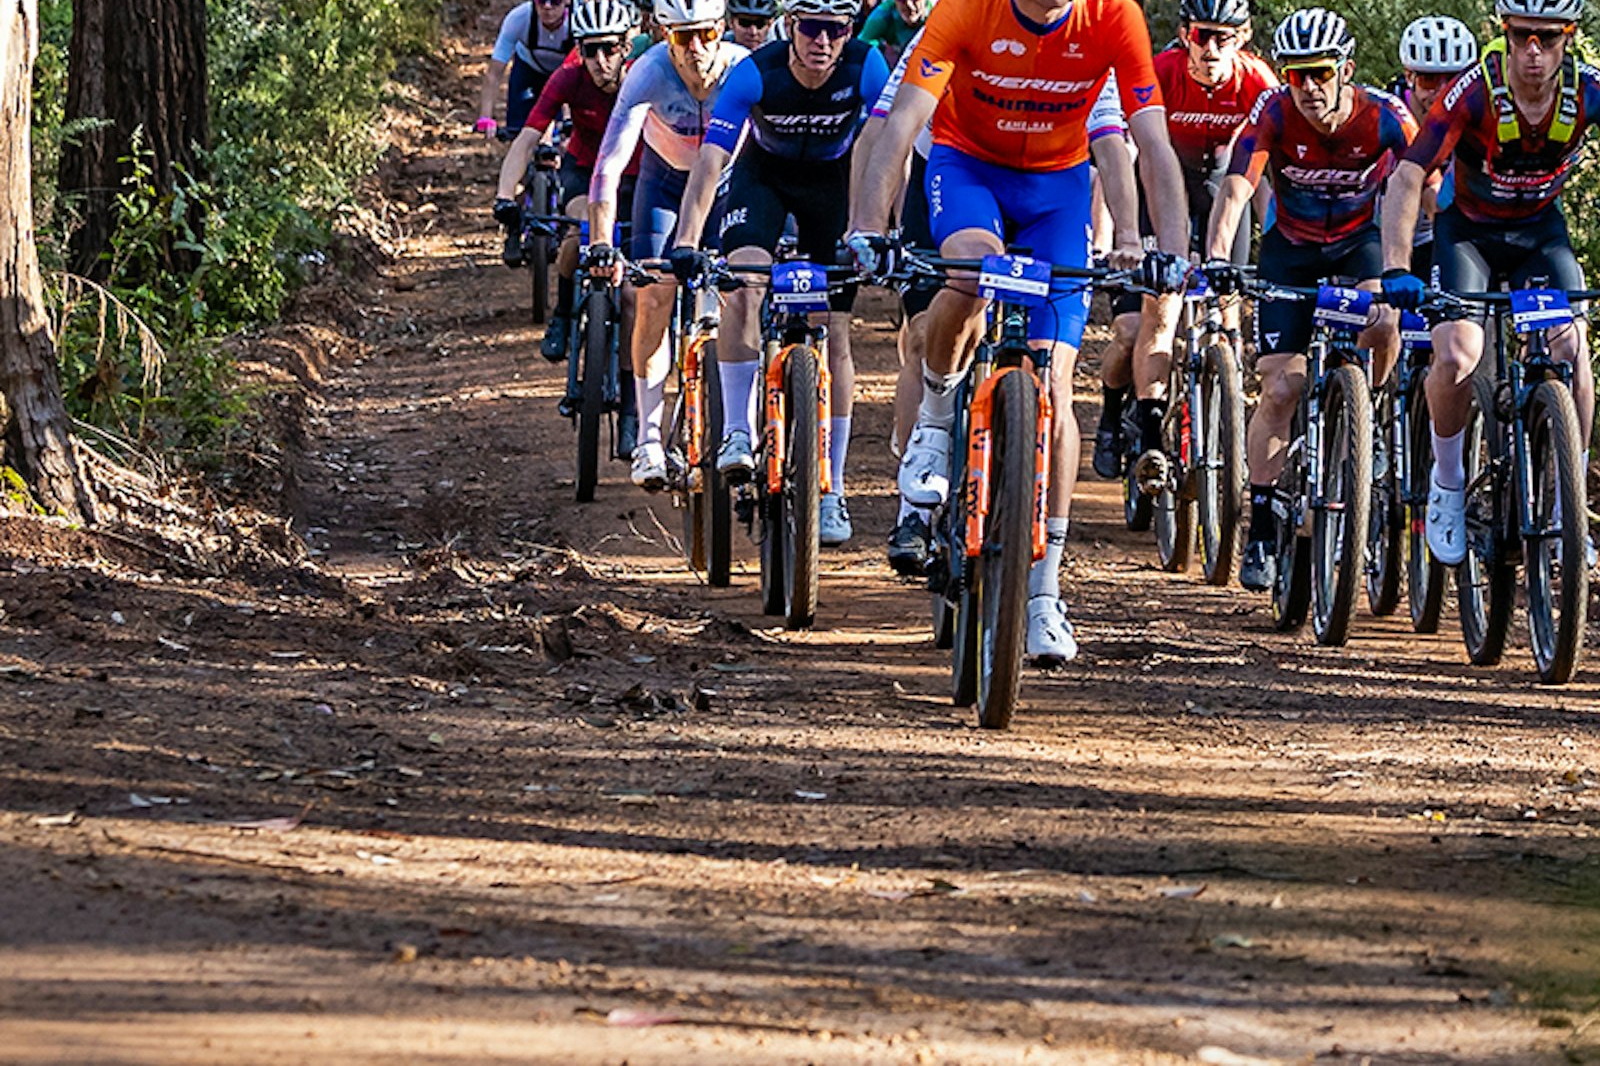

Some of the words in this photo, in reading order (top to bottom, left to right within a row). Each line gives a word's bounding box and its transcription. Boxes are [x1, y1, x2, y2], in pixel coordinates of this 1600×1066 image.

[971, 70, 1095, 93] MERIDA
[1010, 262, 1024, 278] 3
[792, 278, 812, 293] 10
[1338, 298, 1351, 313] 2
